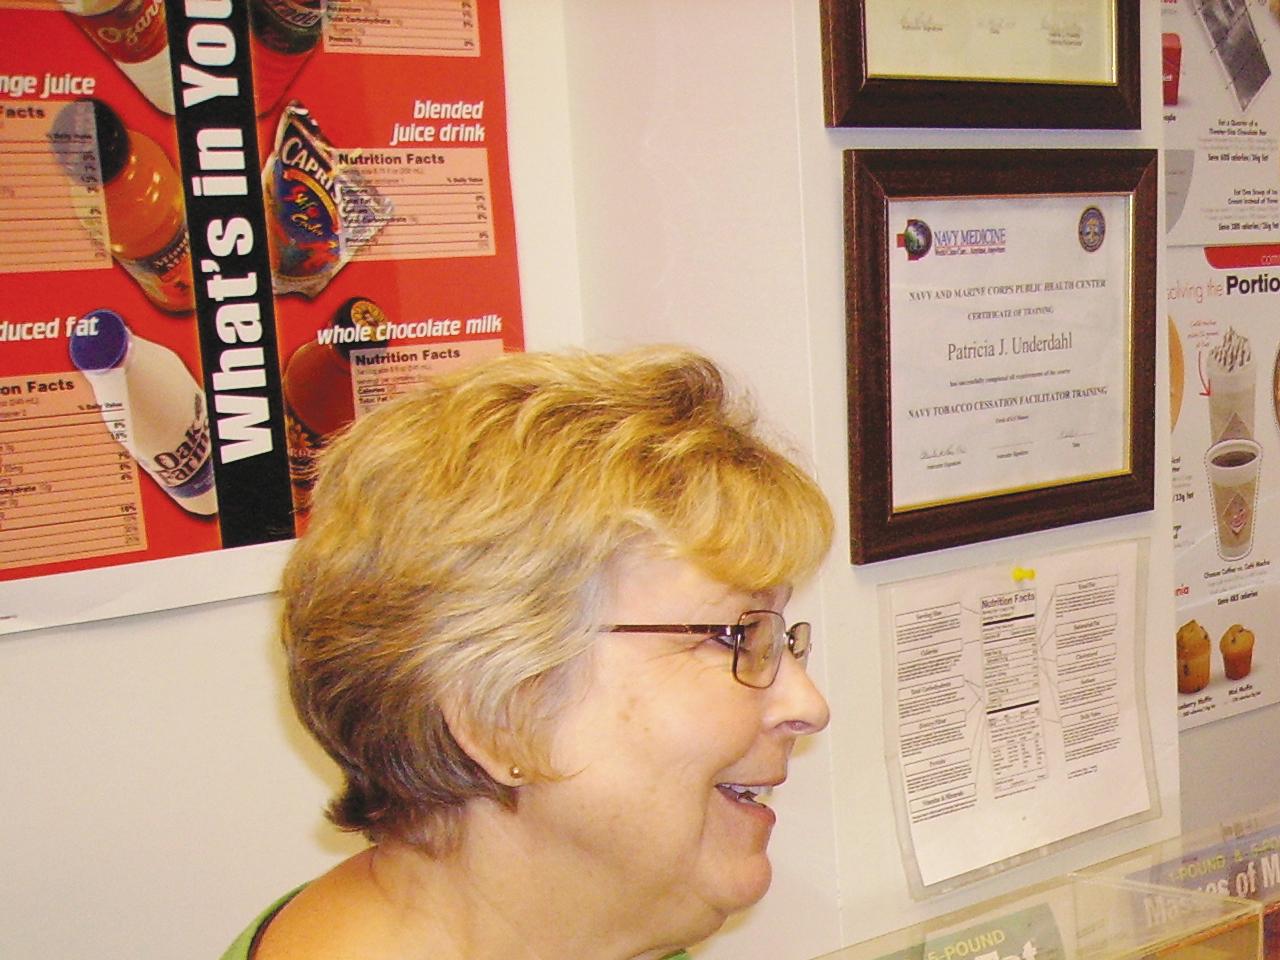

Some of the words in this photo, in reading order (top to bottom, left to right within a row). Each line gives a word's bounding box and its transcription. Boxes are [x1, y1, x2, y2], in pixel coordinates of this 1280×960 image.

[40, 74, 96, 98] juice
[413, 100, 484, 120] blended
[389, 124, 435, 146] juice
[439, 124, 485, 142] drink
[192, 128, 248, 197] in
[338, 153, 401, 165] Nutrition
[406, 153, 445, 165] Facts
[934, 230, 960, 246] NAVY
[961, 228, 1006, 245] MEDICINE
[935, 290, 953, 300] AND
[987, 285, 1014, 296] CORPS
[1015, 283, 1043, 294] PUBLIC
[1044, 280, 1075, 292] HEALTH
[1075, 279, 1107, 290] CENTER
[0, 318, 62, 342] duced
[65, 316, 99, 338] fat
[201, 217, 273, 464] What's
[317, 325, 371, 346] whole
[375, 318, 462, 342] chocolate
[466, 314, 502, 334] milk
[355, 352, 418, 367] Nutrition
[422, 348, 461, 362] Facts
[948, 340, 996, 361] Patricia
[998, 338, 1009, 356] J.
[1012, 332, 1073, 355] Underdahl
[27, 379, 75, 393] Facts
[908, 409, 931, 419] NAVY
[933, 402, 973, 418] TOBACCO
[974, 397, 1018, 413] CESSATION
[1019, 390, 1071, 406] FACILITATOR
[1072, 385, 1108, 400] TRAINING
[981, 596, 1013, 610] Nutrition
[1014, 592, 1035, 604] Facts
[1235, 862, 1258, 899] of
